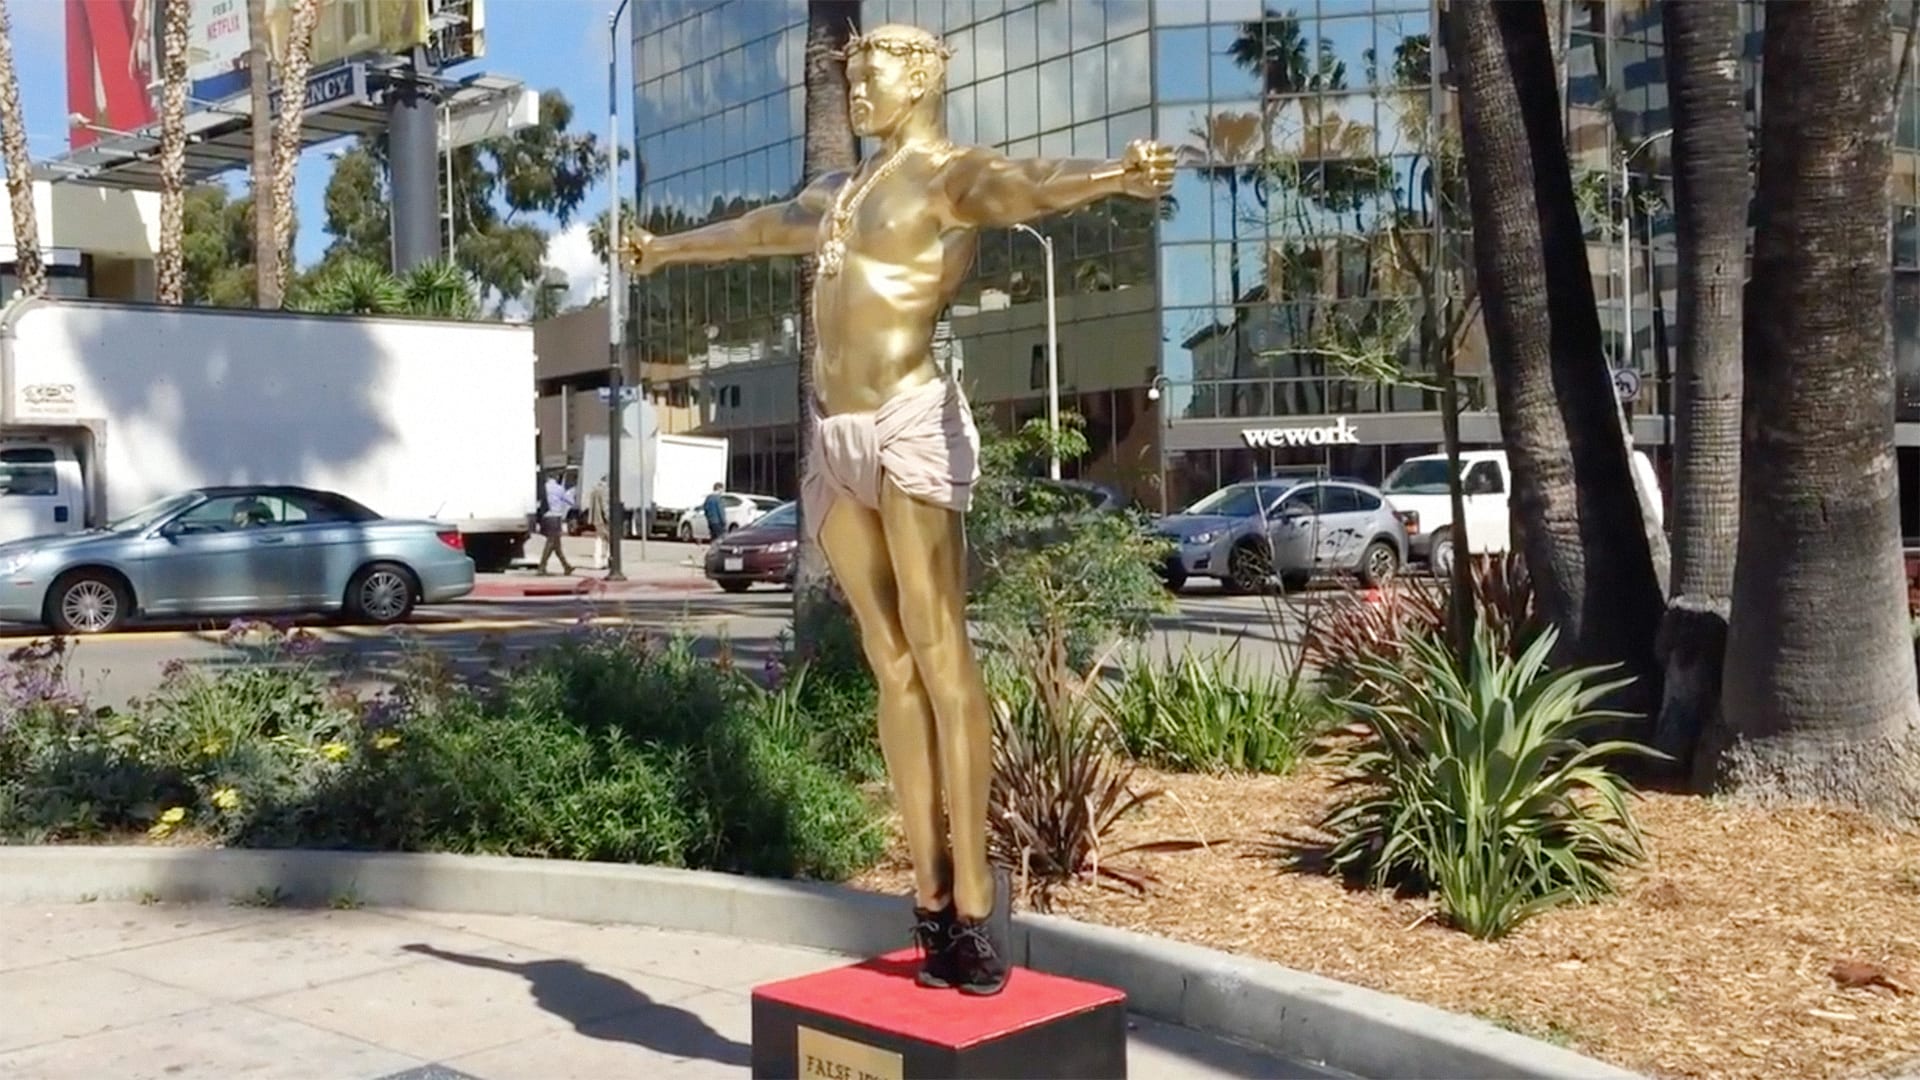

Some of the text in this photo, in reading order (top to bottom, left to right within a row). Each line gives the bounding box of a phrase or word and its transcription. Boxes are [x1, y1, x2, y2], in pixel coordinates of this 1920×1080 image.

[207, 15, 240, 39] NETFLIX
[1241, 416, 1360, 447] wework
[806, 1055, 851, 1080] FALSE
